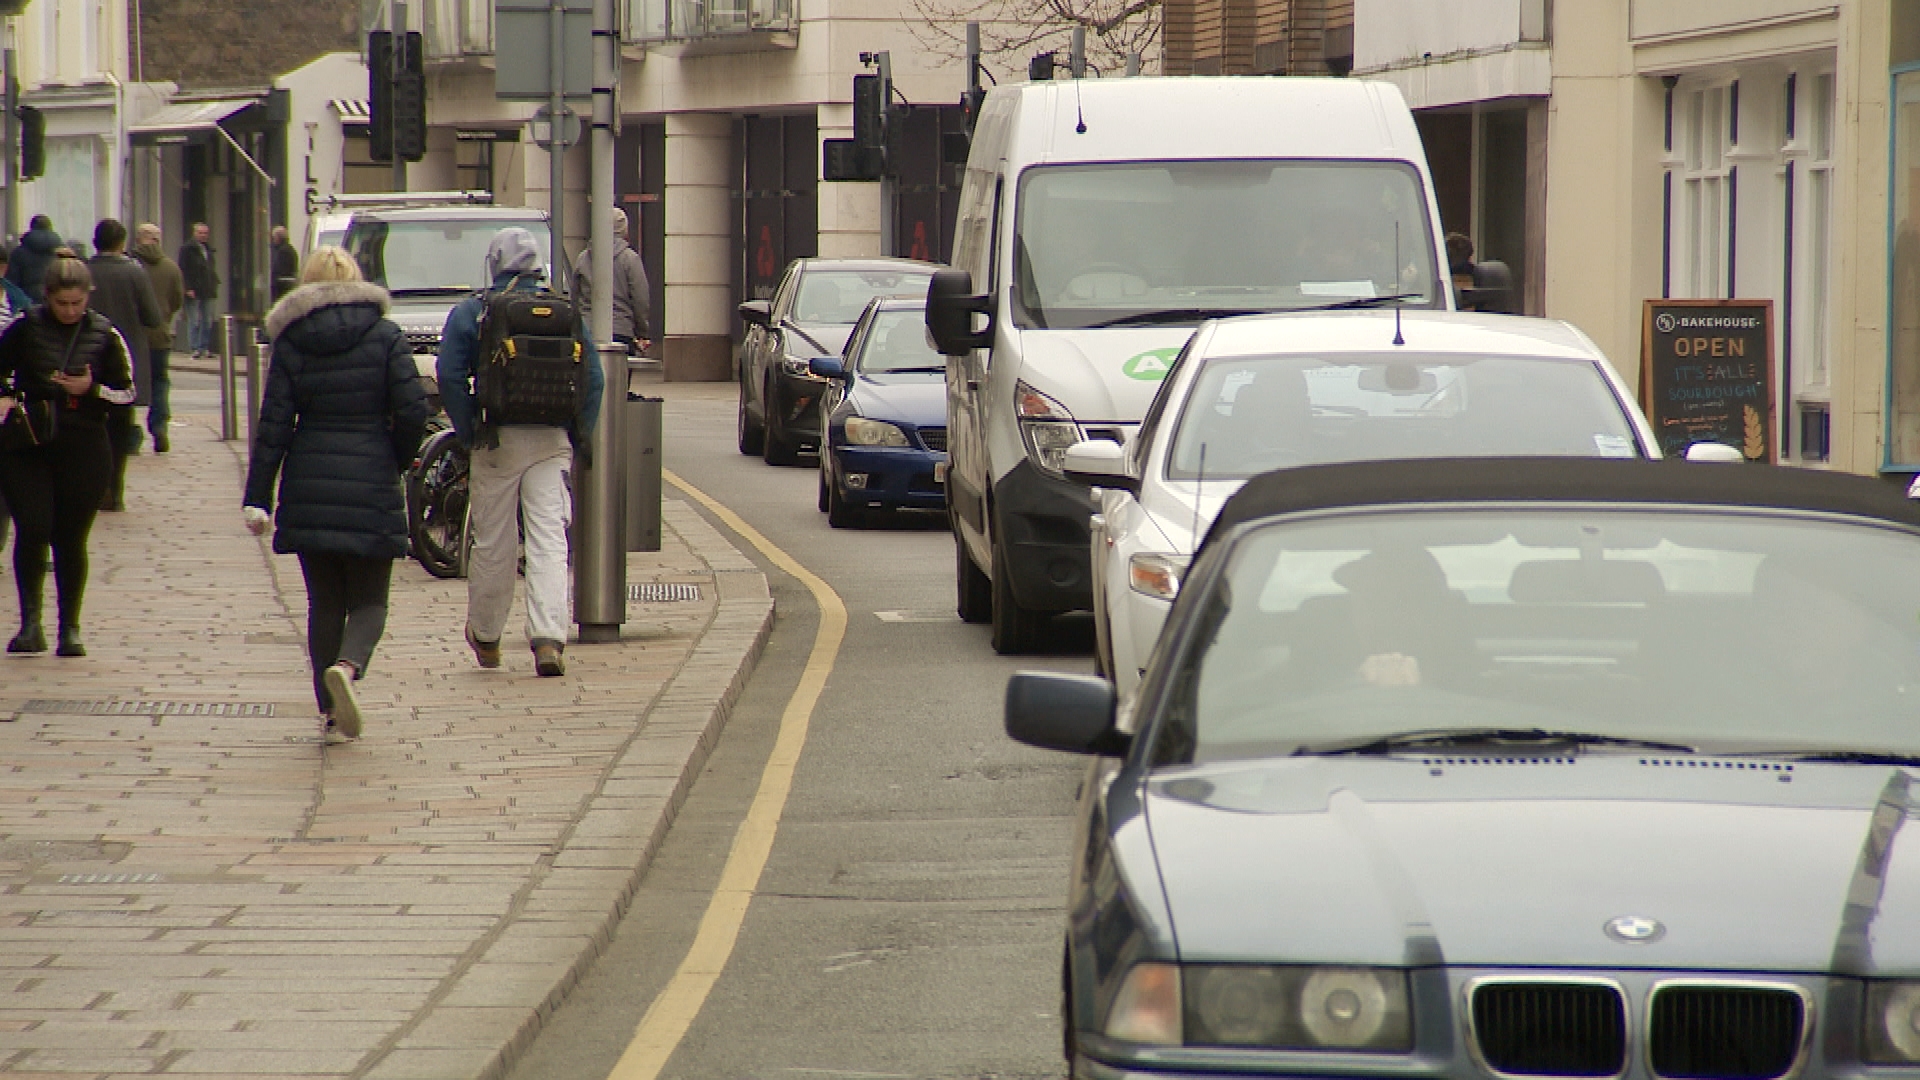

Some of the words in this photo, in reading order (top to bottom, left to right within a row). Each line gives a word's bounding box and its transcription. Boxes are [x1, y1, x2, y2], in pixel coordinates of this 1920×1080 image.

[1681, 317, 1756, 327] BAKEHOUSE
[1674, 337, 1744, 357] OPEN
[1132, 355, 1177, 373] A
[1715, 363, 1749, 379] ALL
[1668, 384, 1757, 401] SOURDOUGH
